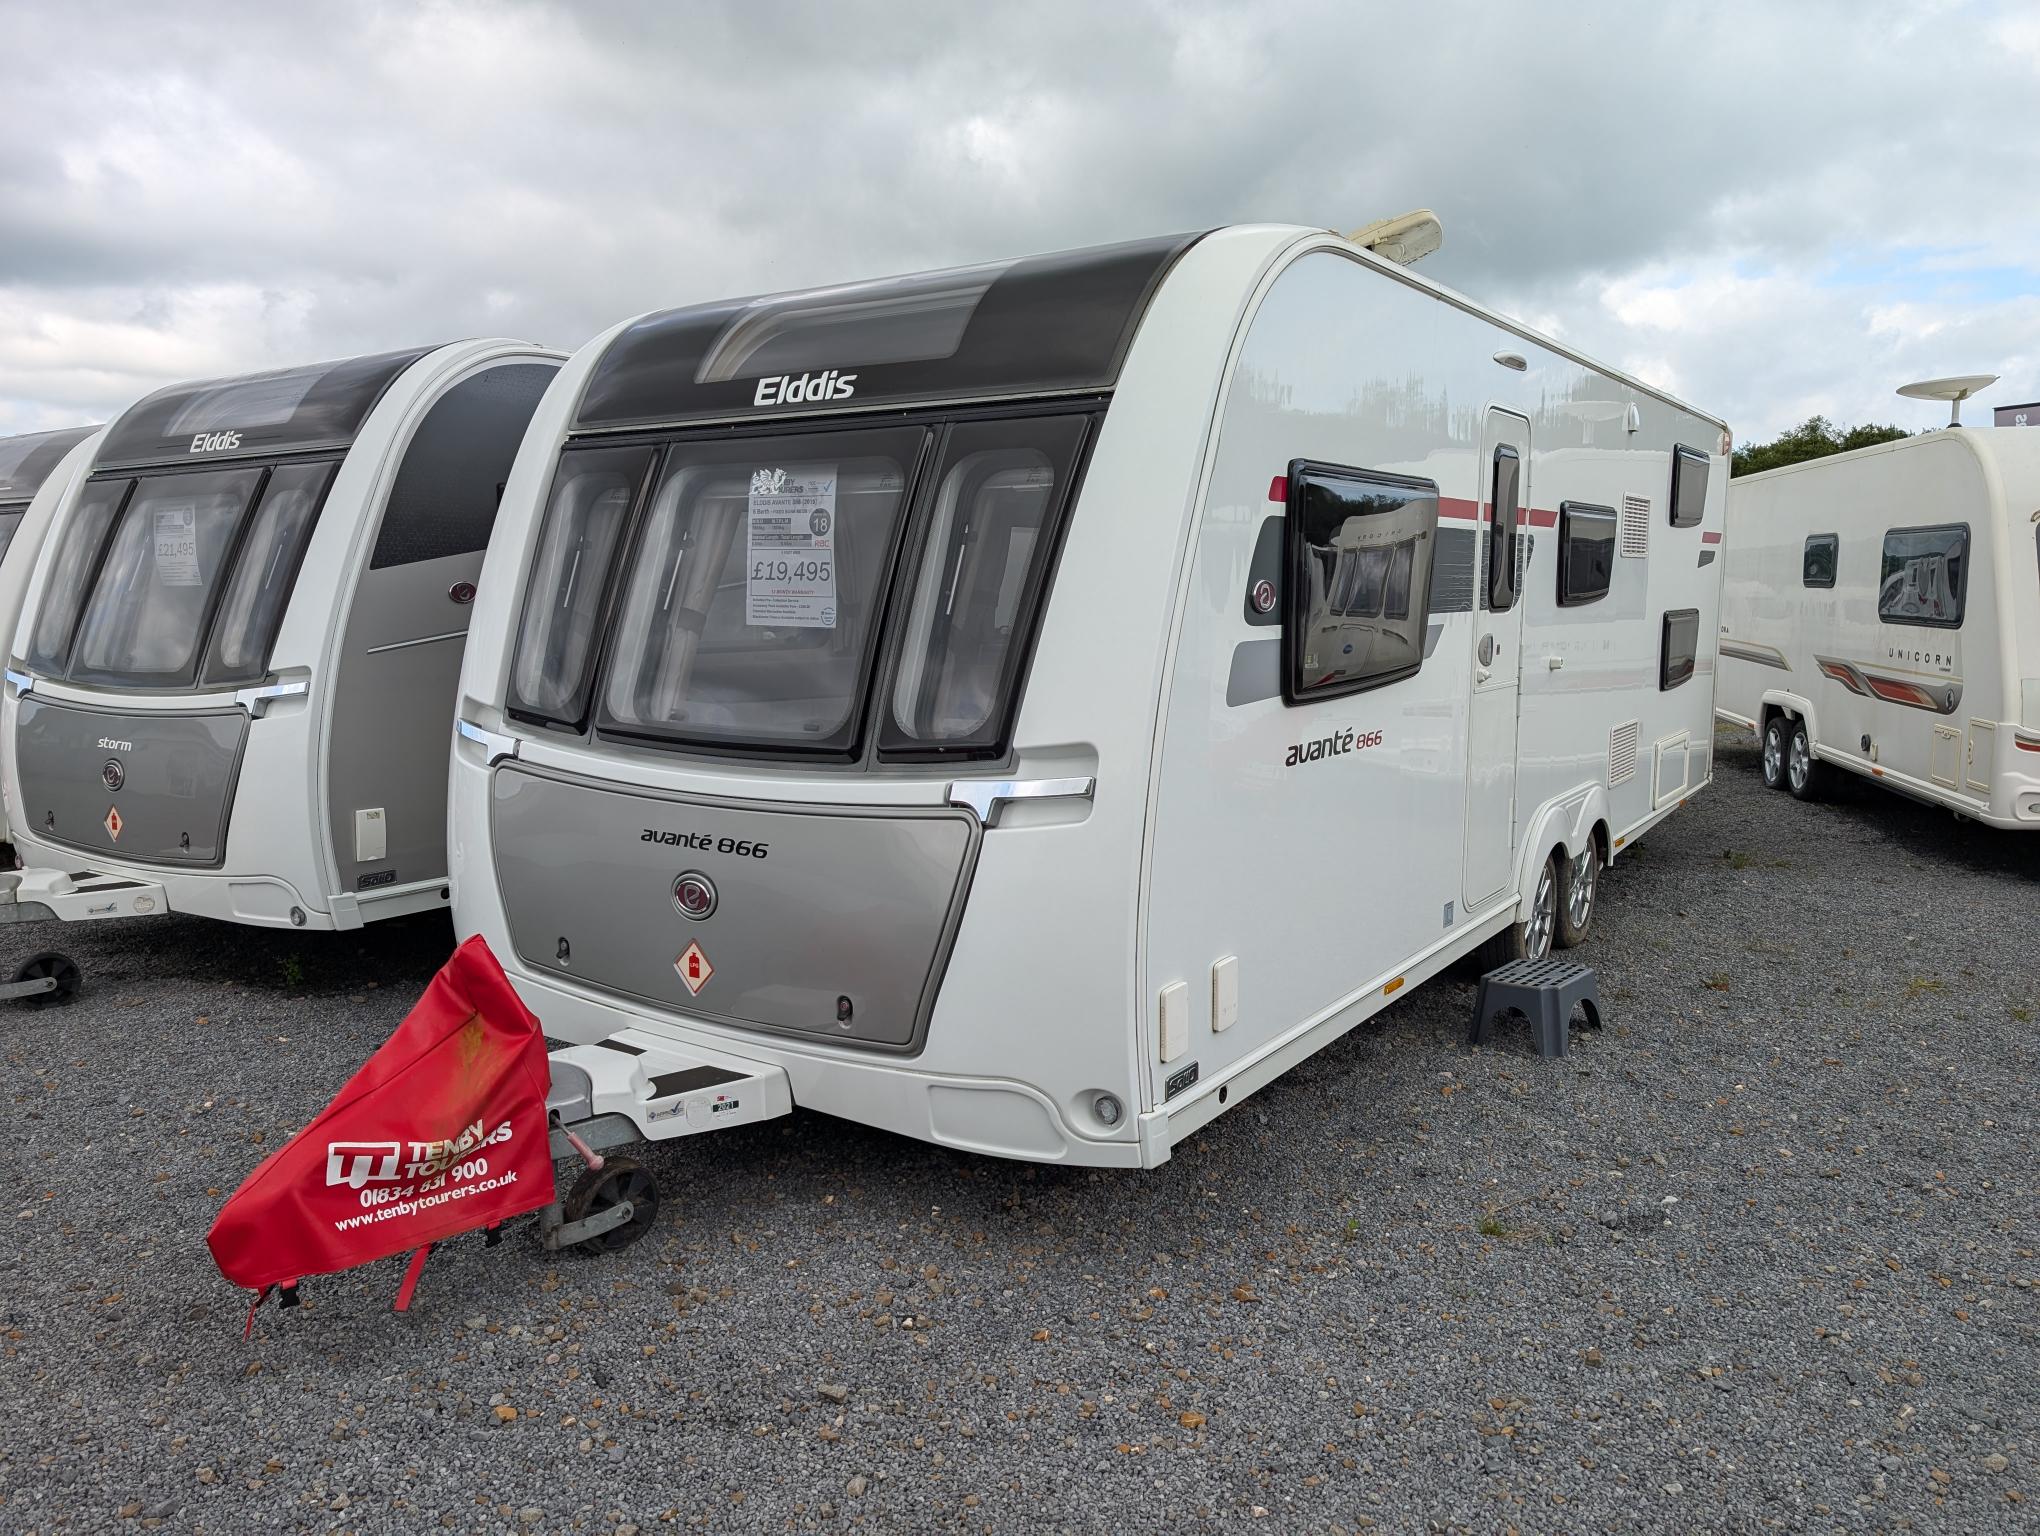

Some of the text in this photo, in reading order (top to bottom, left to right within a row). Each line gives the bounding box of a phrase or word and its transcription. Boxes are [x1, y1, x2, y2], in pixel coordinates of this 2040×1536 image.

[753, 370, 858, 406] Elddis
[189, 430, 243, 453] Elddis
[813, 518, 828, 532] 18
[158, 542, 194, 558] £21,495
[751, 561, 830, 584] £19,495
[1888, 647, 1953, 666] UNICORN
[97, 736, 132, 752] storm
[1285, 726, 1383, 767] avanté 866
[640, 828, 770, 859] avanté 866
[407, 1119, 484, 1162] TENBY
[359, 1157, 489, 1208] 01834 831 900
[335, 1170, 517, 1232] www.tenbytourers.co.uk
